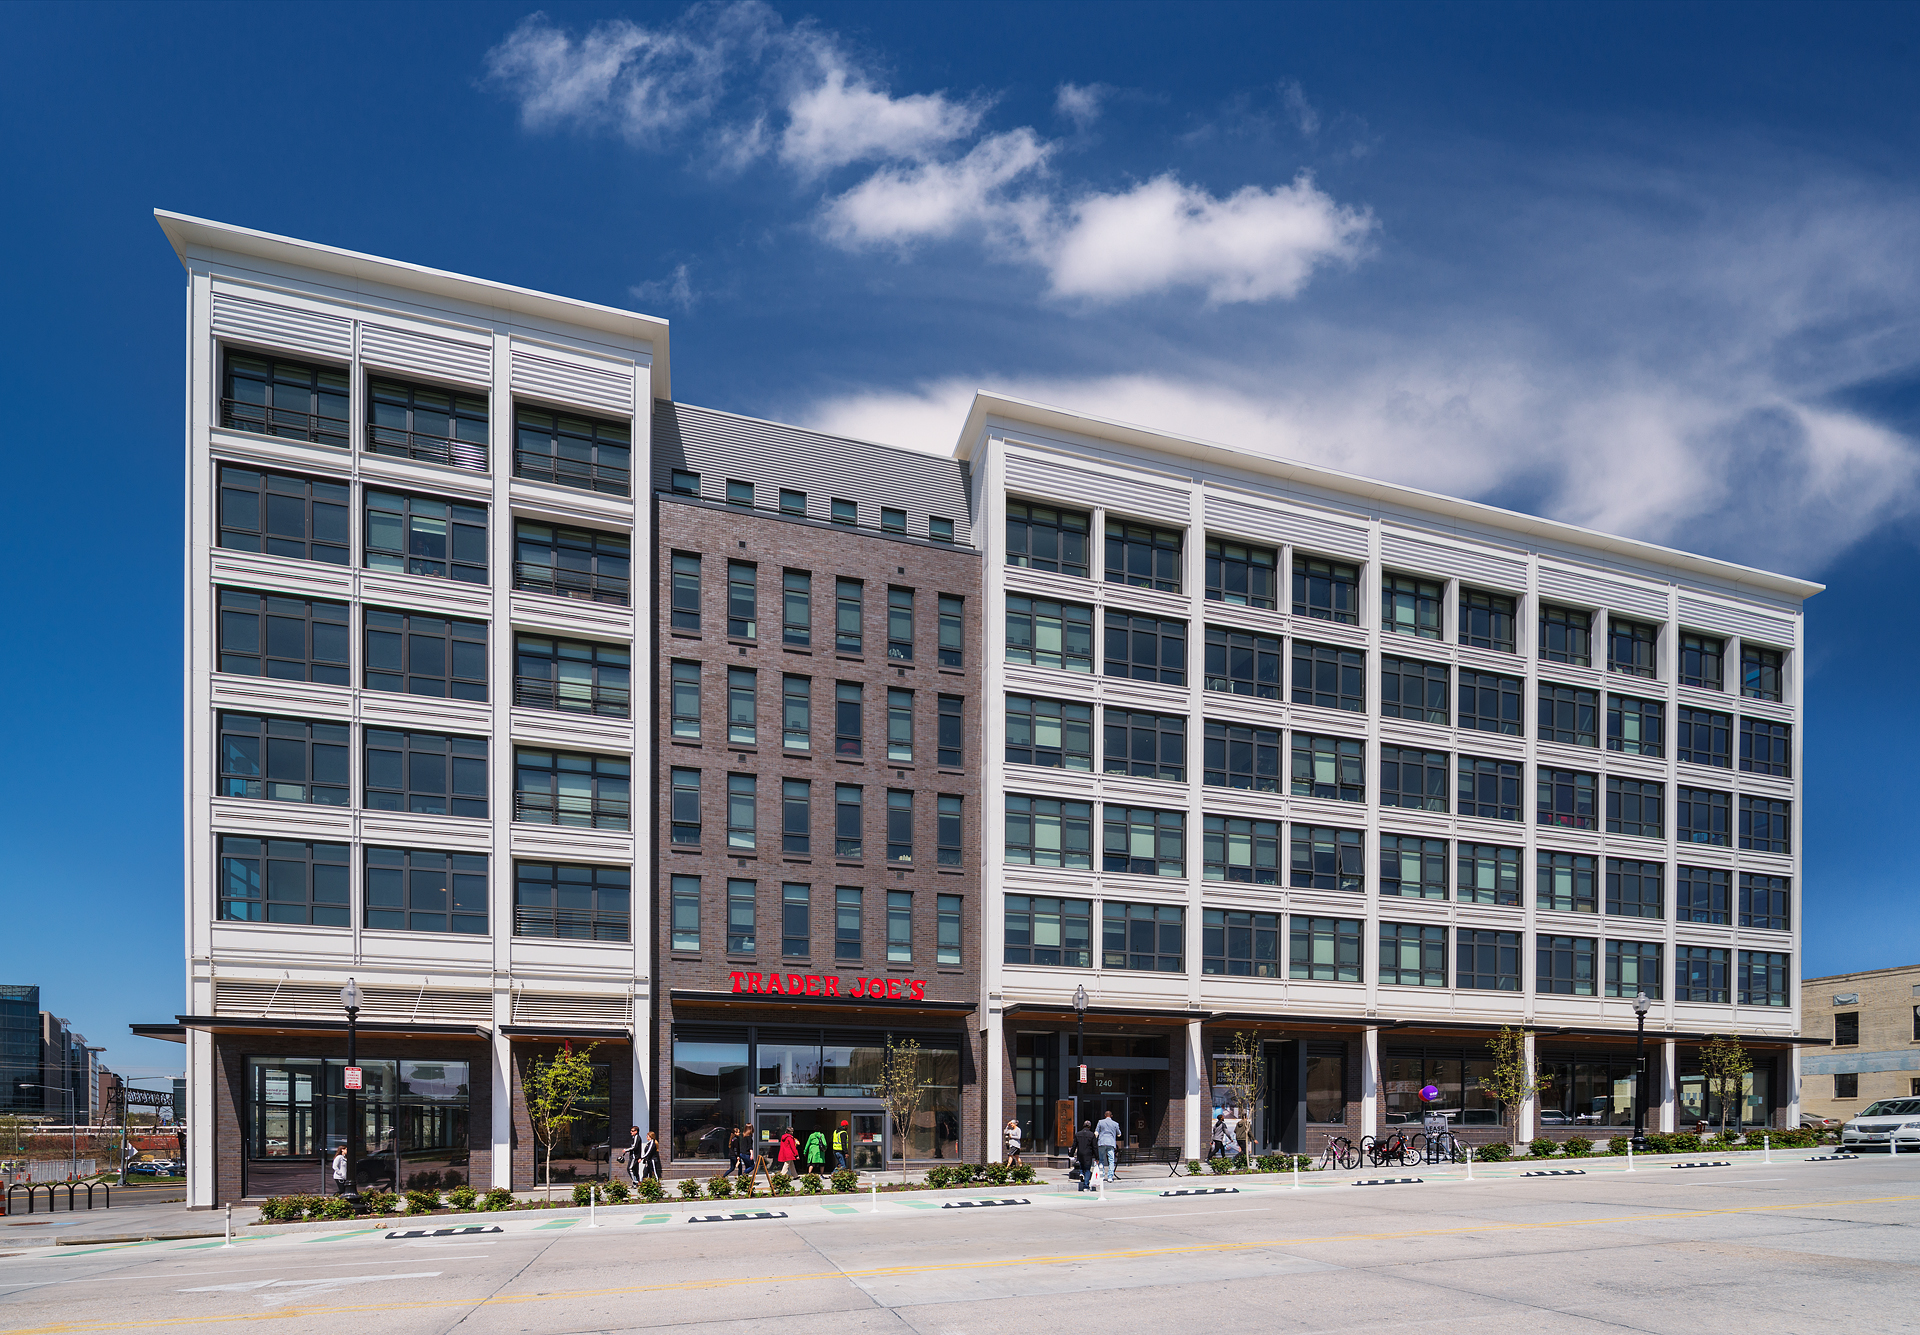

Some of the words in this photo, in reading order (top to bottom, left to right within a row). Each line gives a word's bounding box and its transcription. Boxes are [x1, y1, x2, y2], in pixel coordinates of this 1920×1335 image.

[728, 971, 841, 997] TRADER
[849, 977, 927, 1000] JOE'S
[1095, 1079, 1112, 1087] 1240
